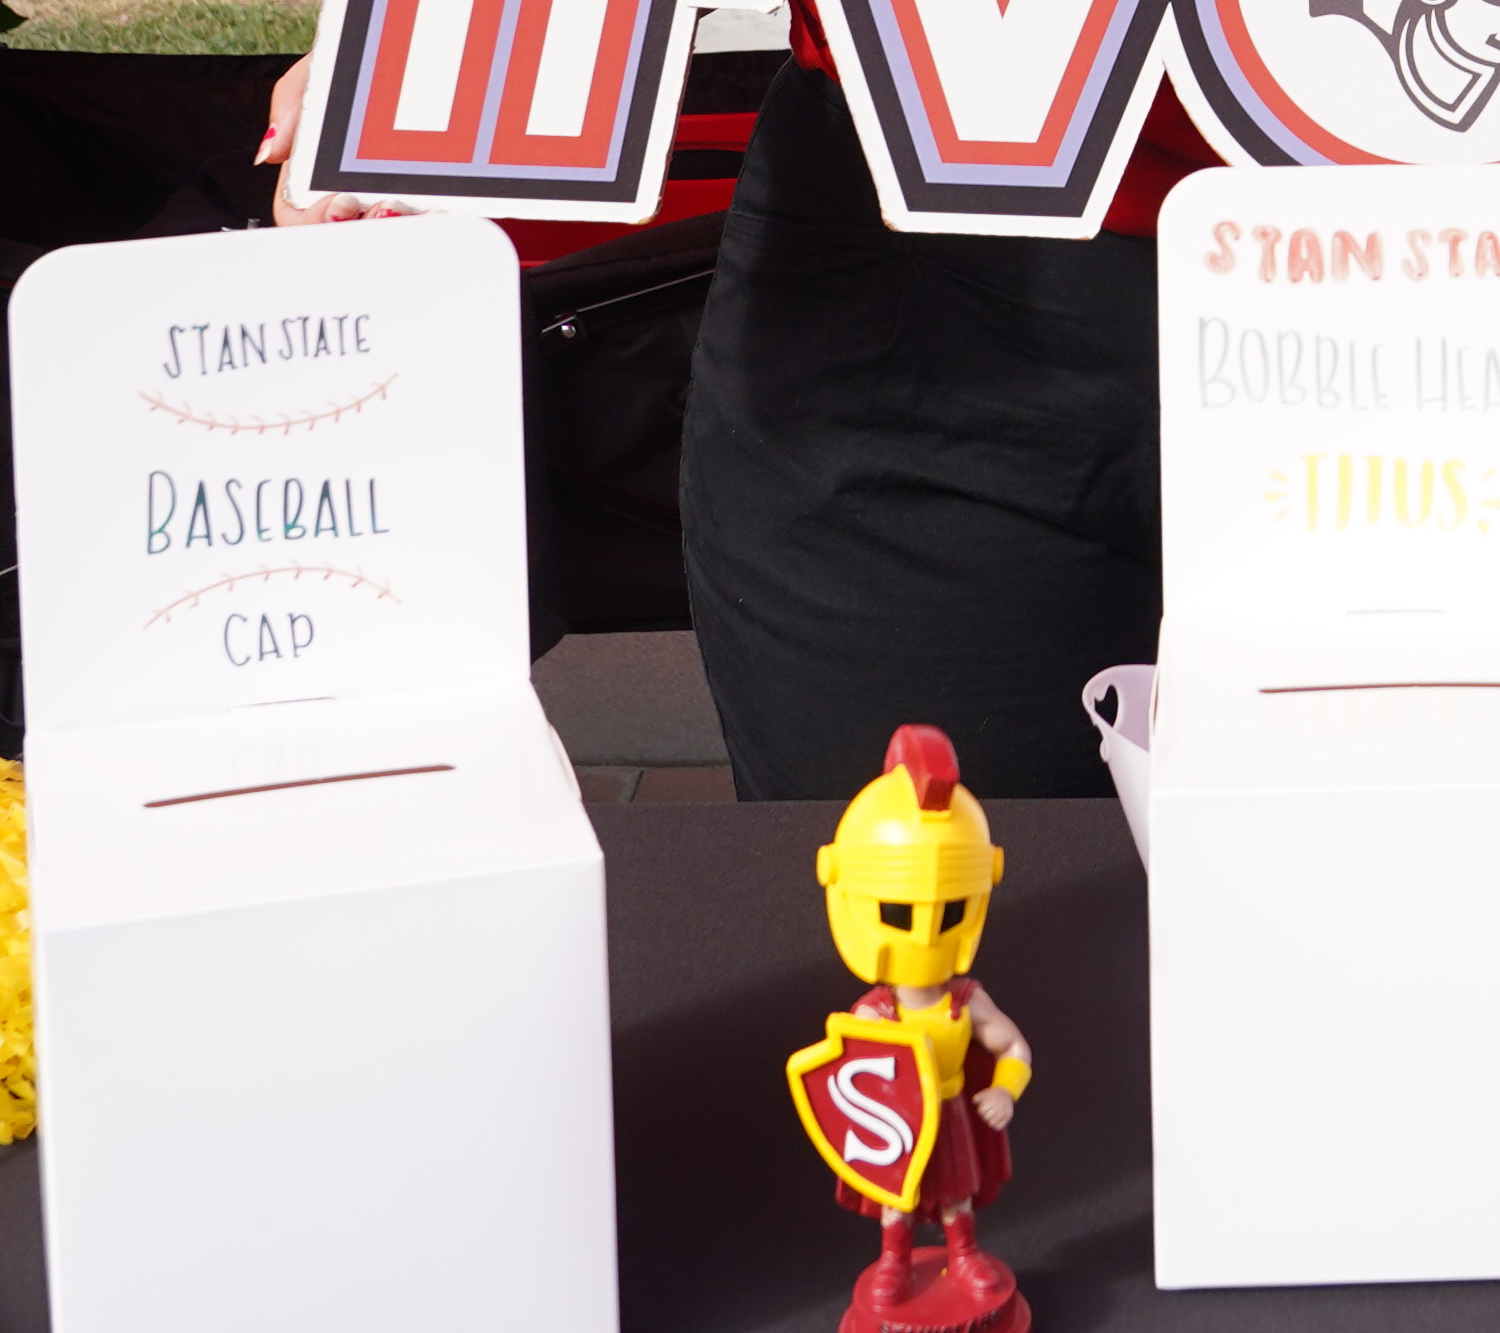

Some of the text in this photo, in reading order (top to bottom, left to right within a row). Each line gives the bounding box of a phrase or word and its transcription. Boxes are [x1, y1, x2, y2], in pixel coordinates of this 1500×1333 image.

[1203, 219, 1385, 285] STAN
[162, 313, 372, 380] STAN STATE
[145, 469, 391, 557] BASEBALL
[1301, 452, 1471, 534] TITUS
[223, 612, 316, 668] CAP
[826, 1056, 914, 1167] S
